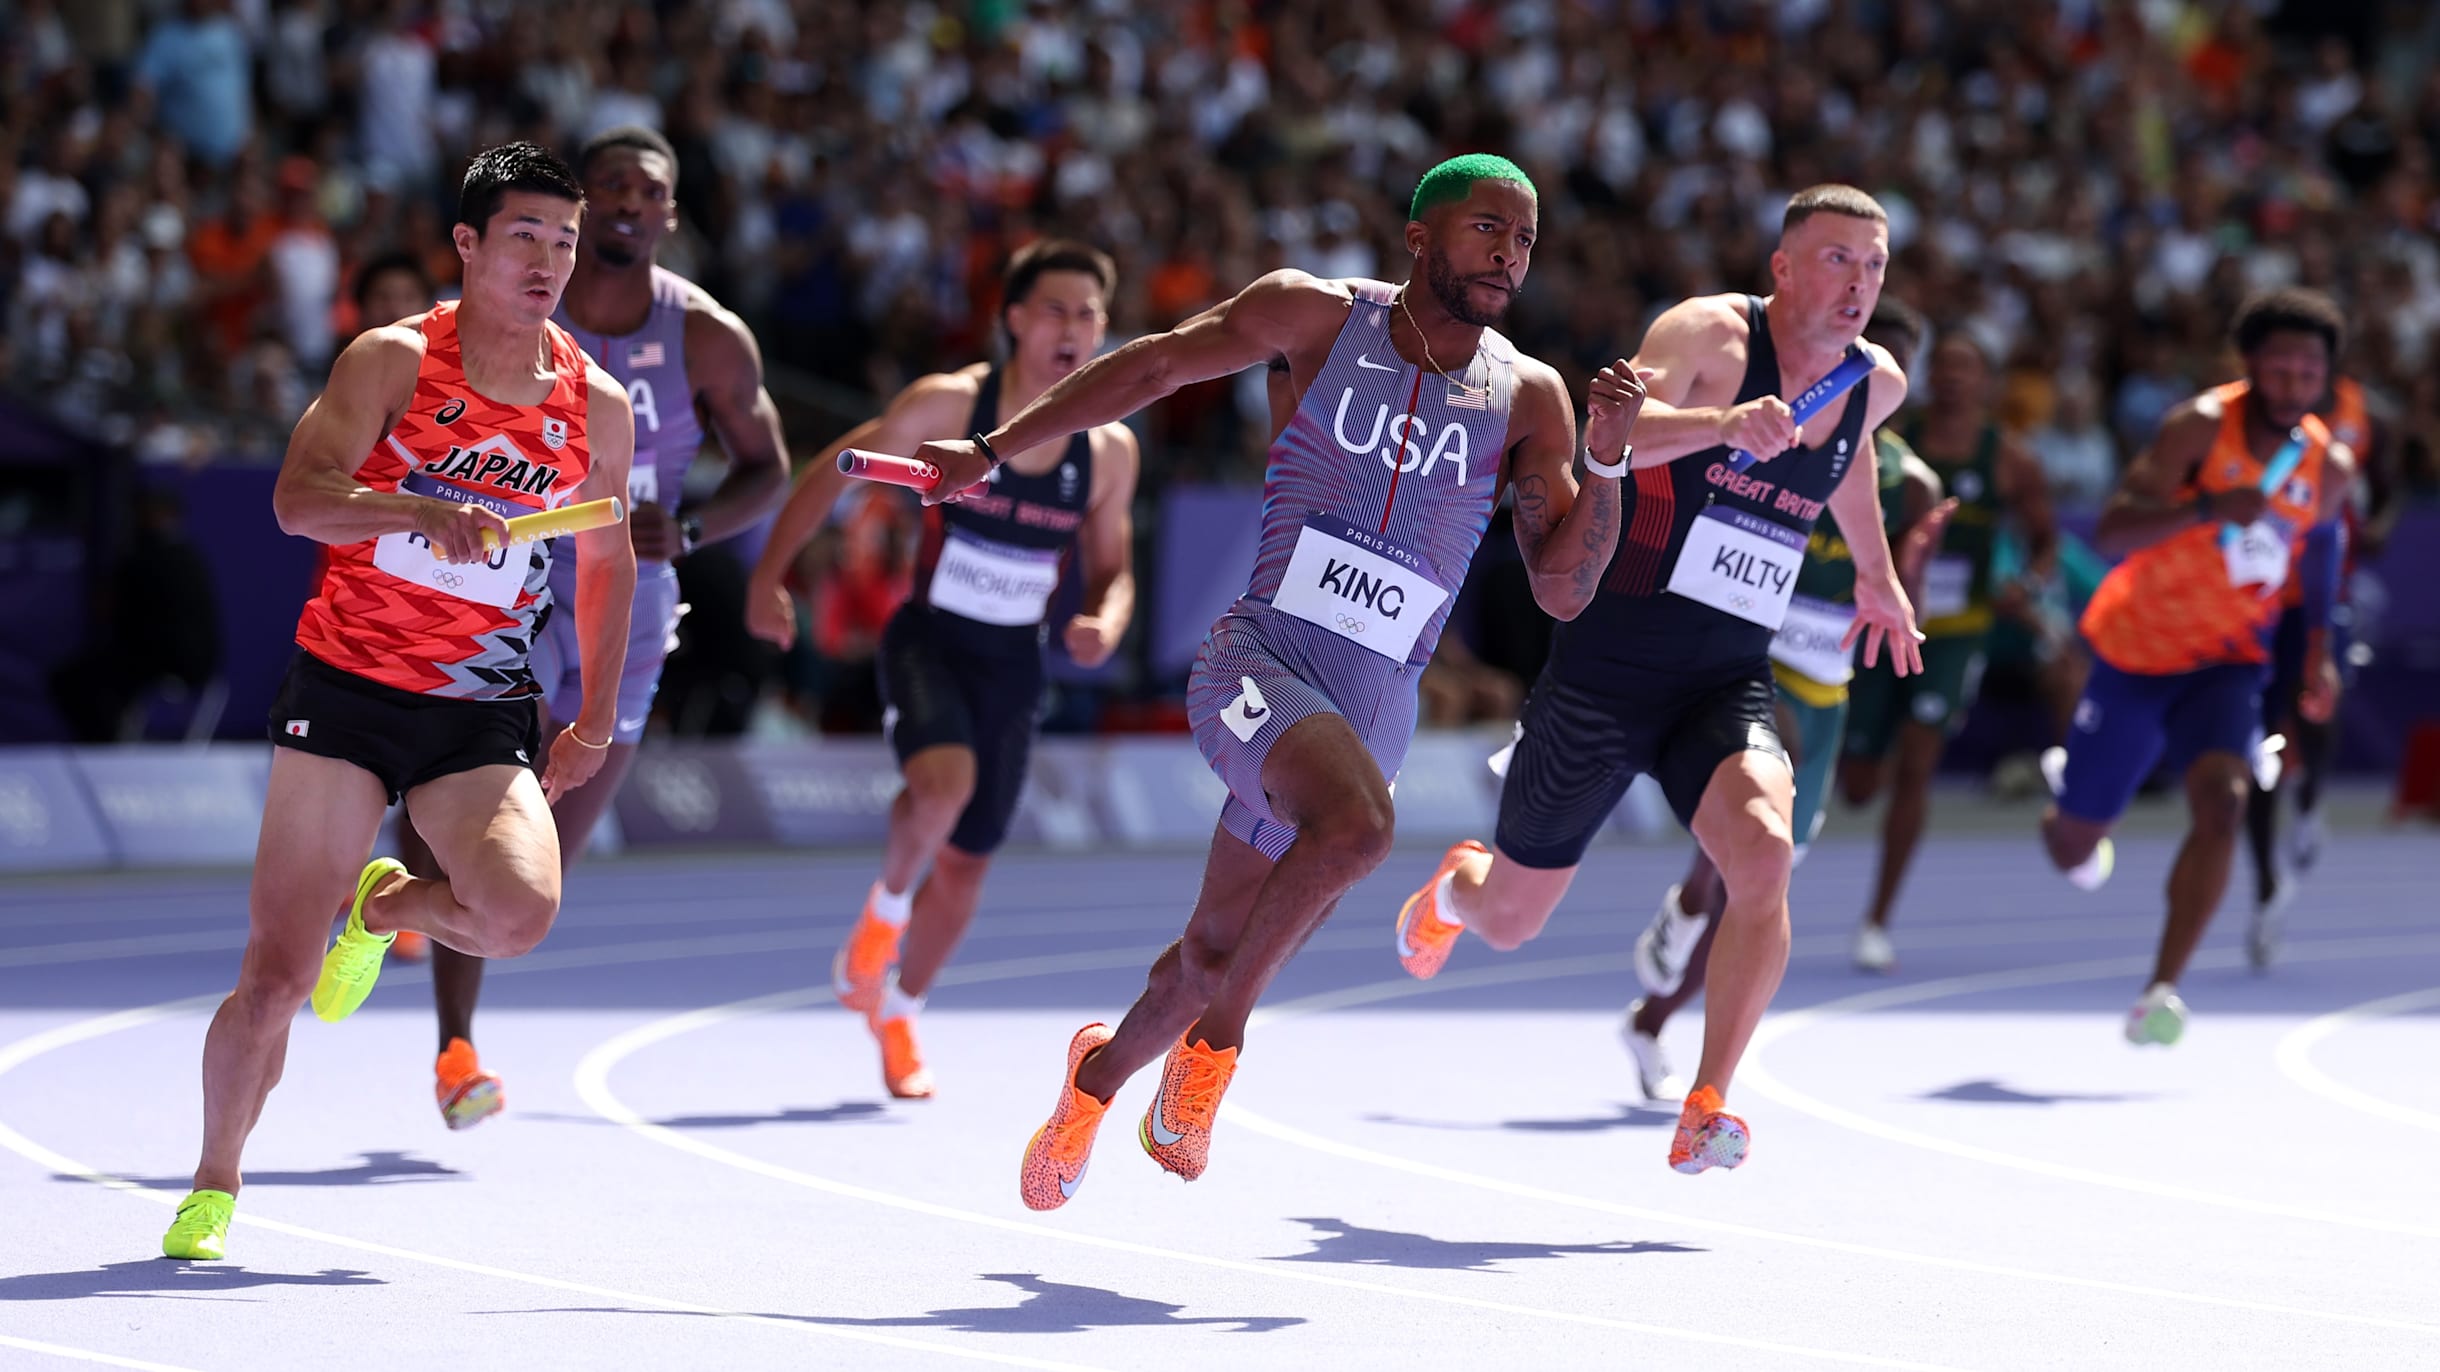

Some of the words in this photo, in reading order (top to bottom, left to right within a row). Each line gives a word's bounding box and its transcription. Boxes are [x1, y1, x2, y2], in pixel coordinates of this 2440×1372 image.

[1797, 379, 1834, 409] 2024
[1333, 387, 1470, 487] USA
[424, 446, 560, 496] JAPAN
[1705, 463, 1776, 503] GREAT
[435, 484, 474, 505] PARIS
[1734, 514, 1769, 535] PARIS
[1346, 527, 1384, 551] PARIS
[1386, 544, 1421, 569] 2024
[1318, 558, 1406, 621] KING
[1711, 544, 1793, 596] KILTY
